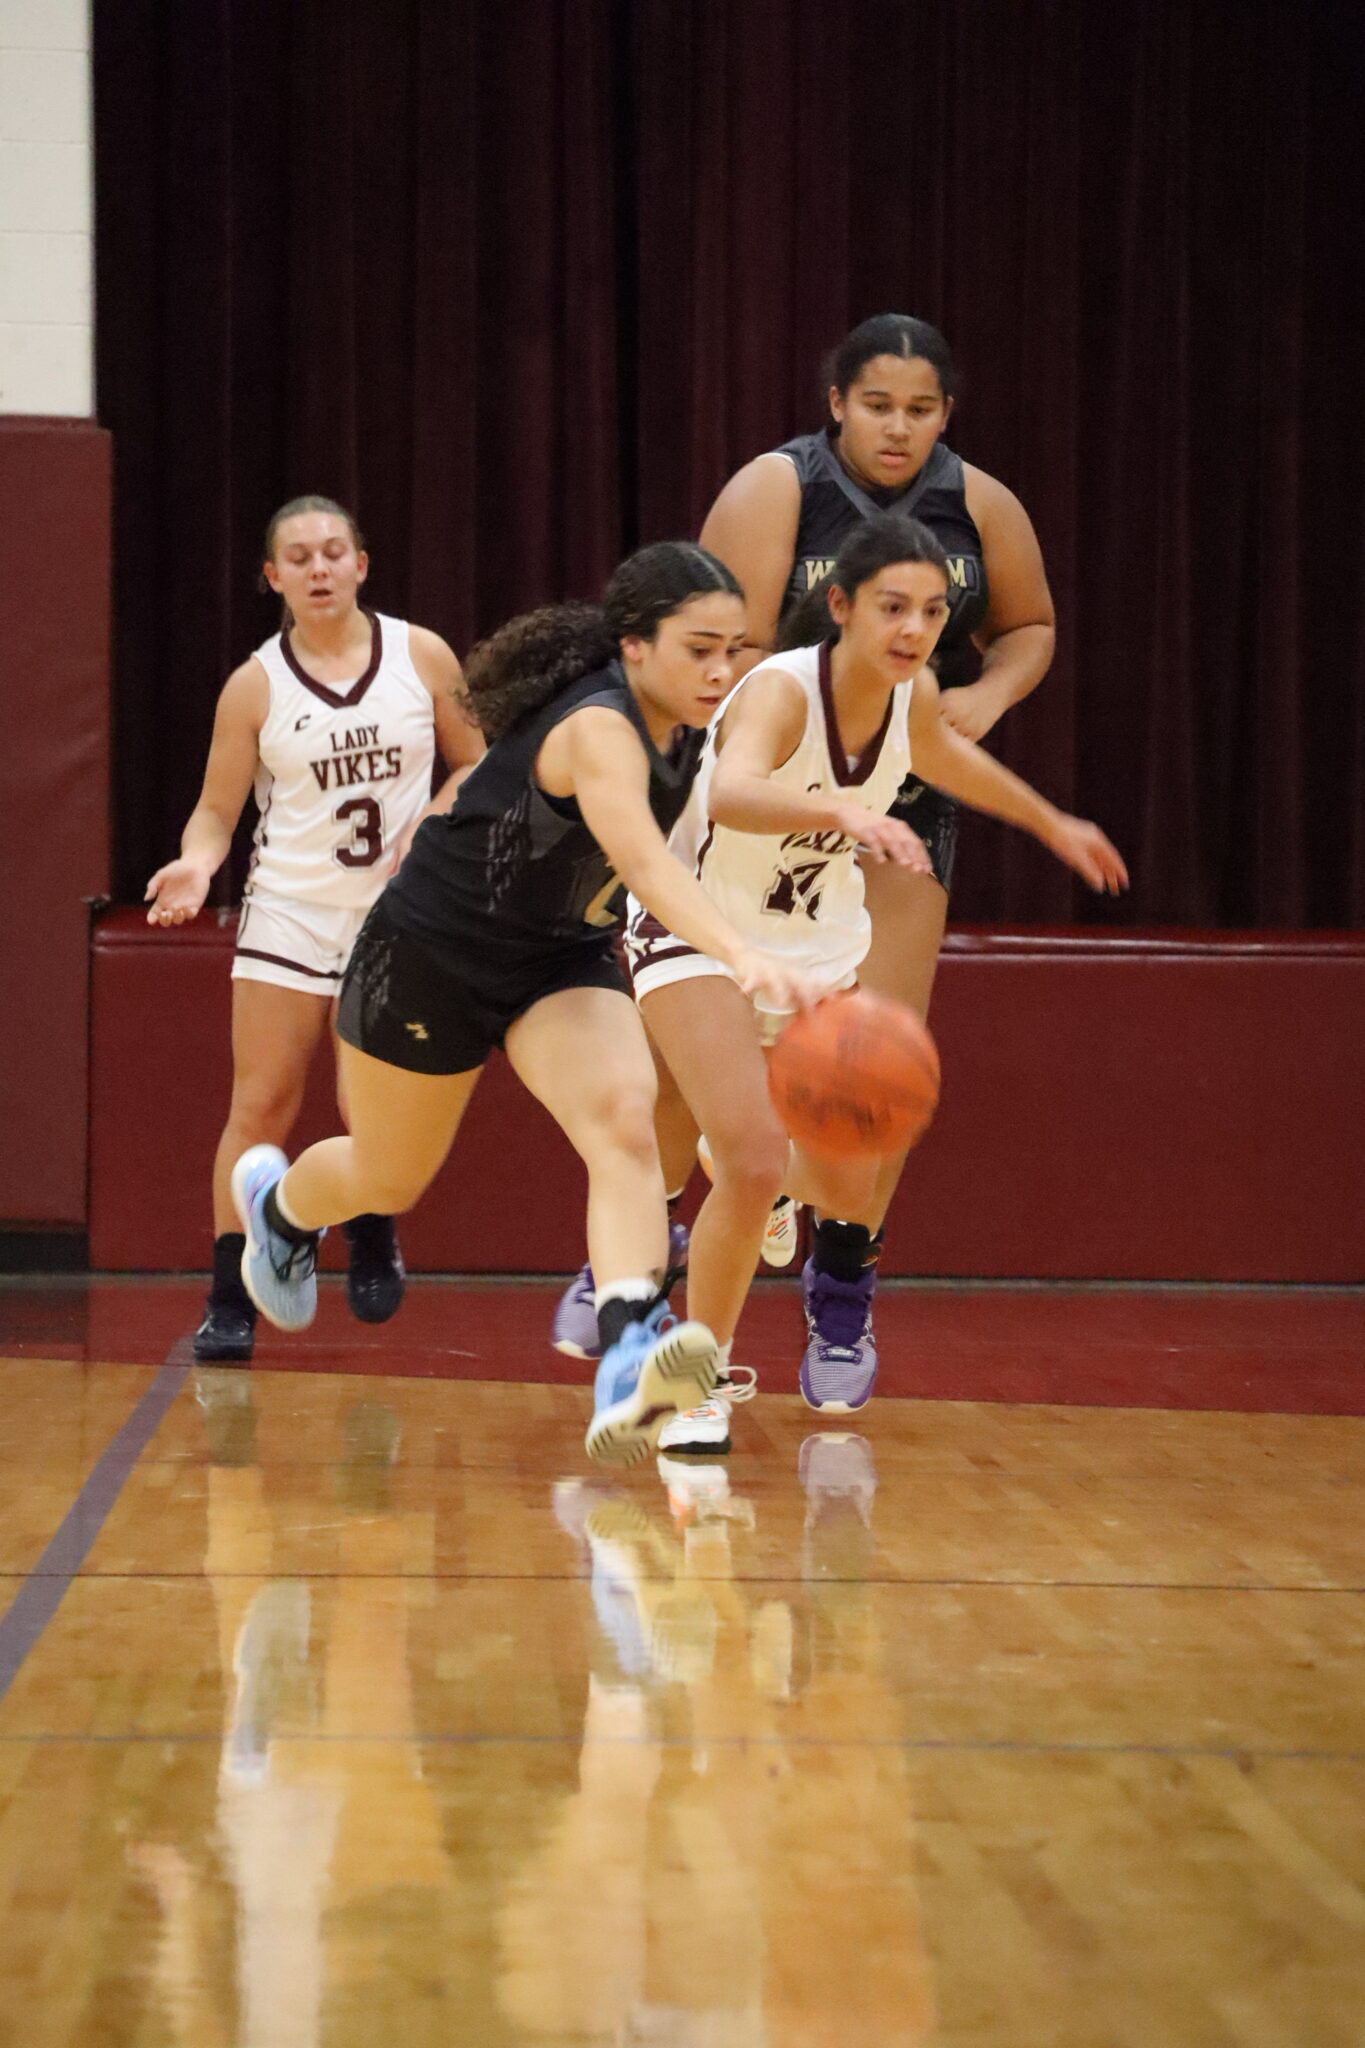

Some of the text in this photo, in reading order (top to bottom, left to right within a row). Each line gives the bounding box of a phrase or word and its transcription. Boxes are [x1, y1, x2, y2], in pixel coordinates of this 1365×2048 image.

[330, 724, 380, 753] LADY
[310, 745, 402, 792] VIKES
[333, 795, 385, 871] 3
